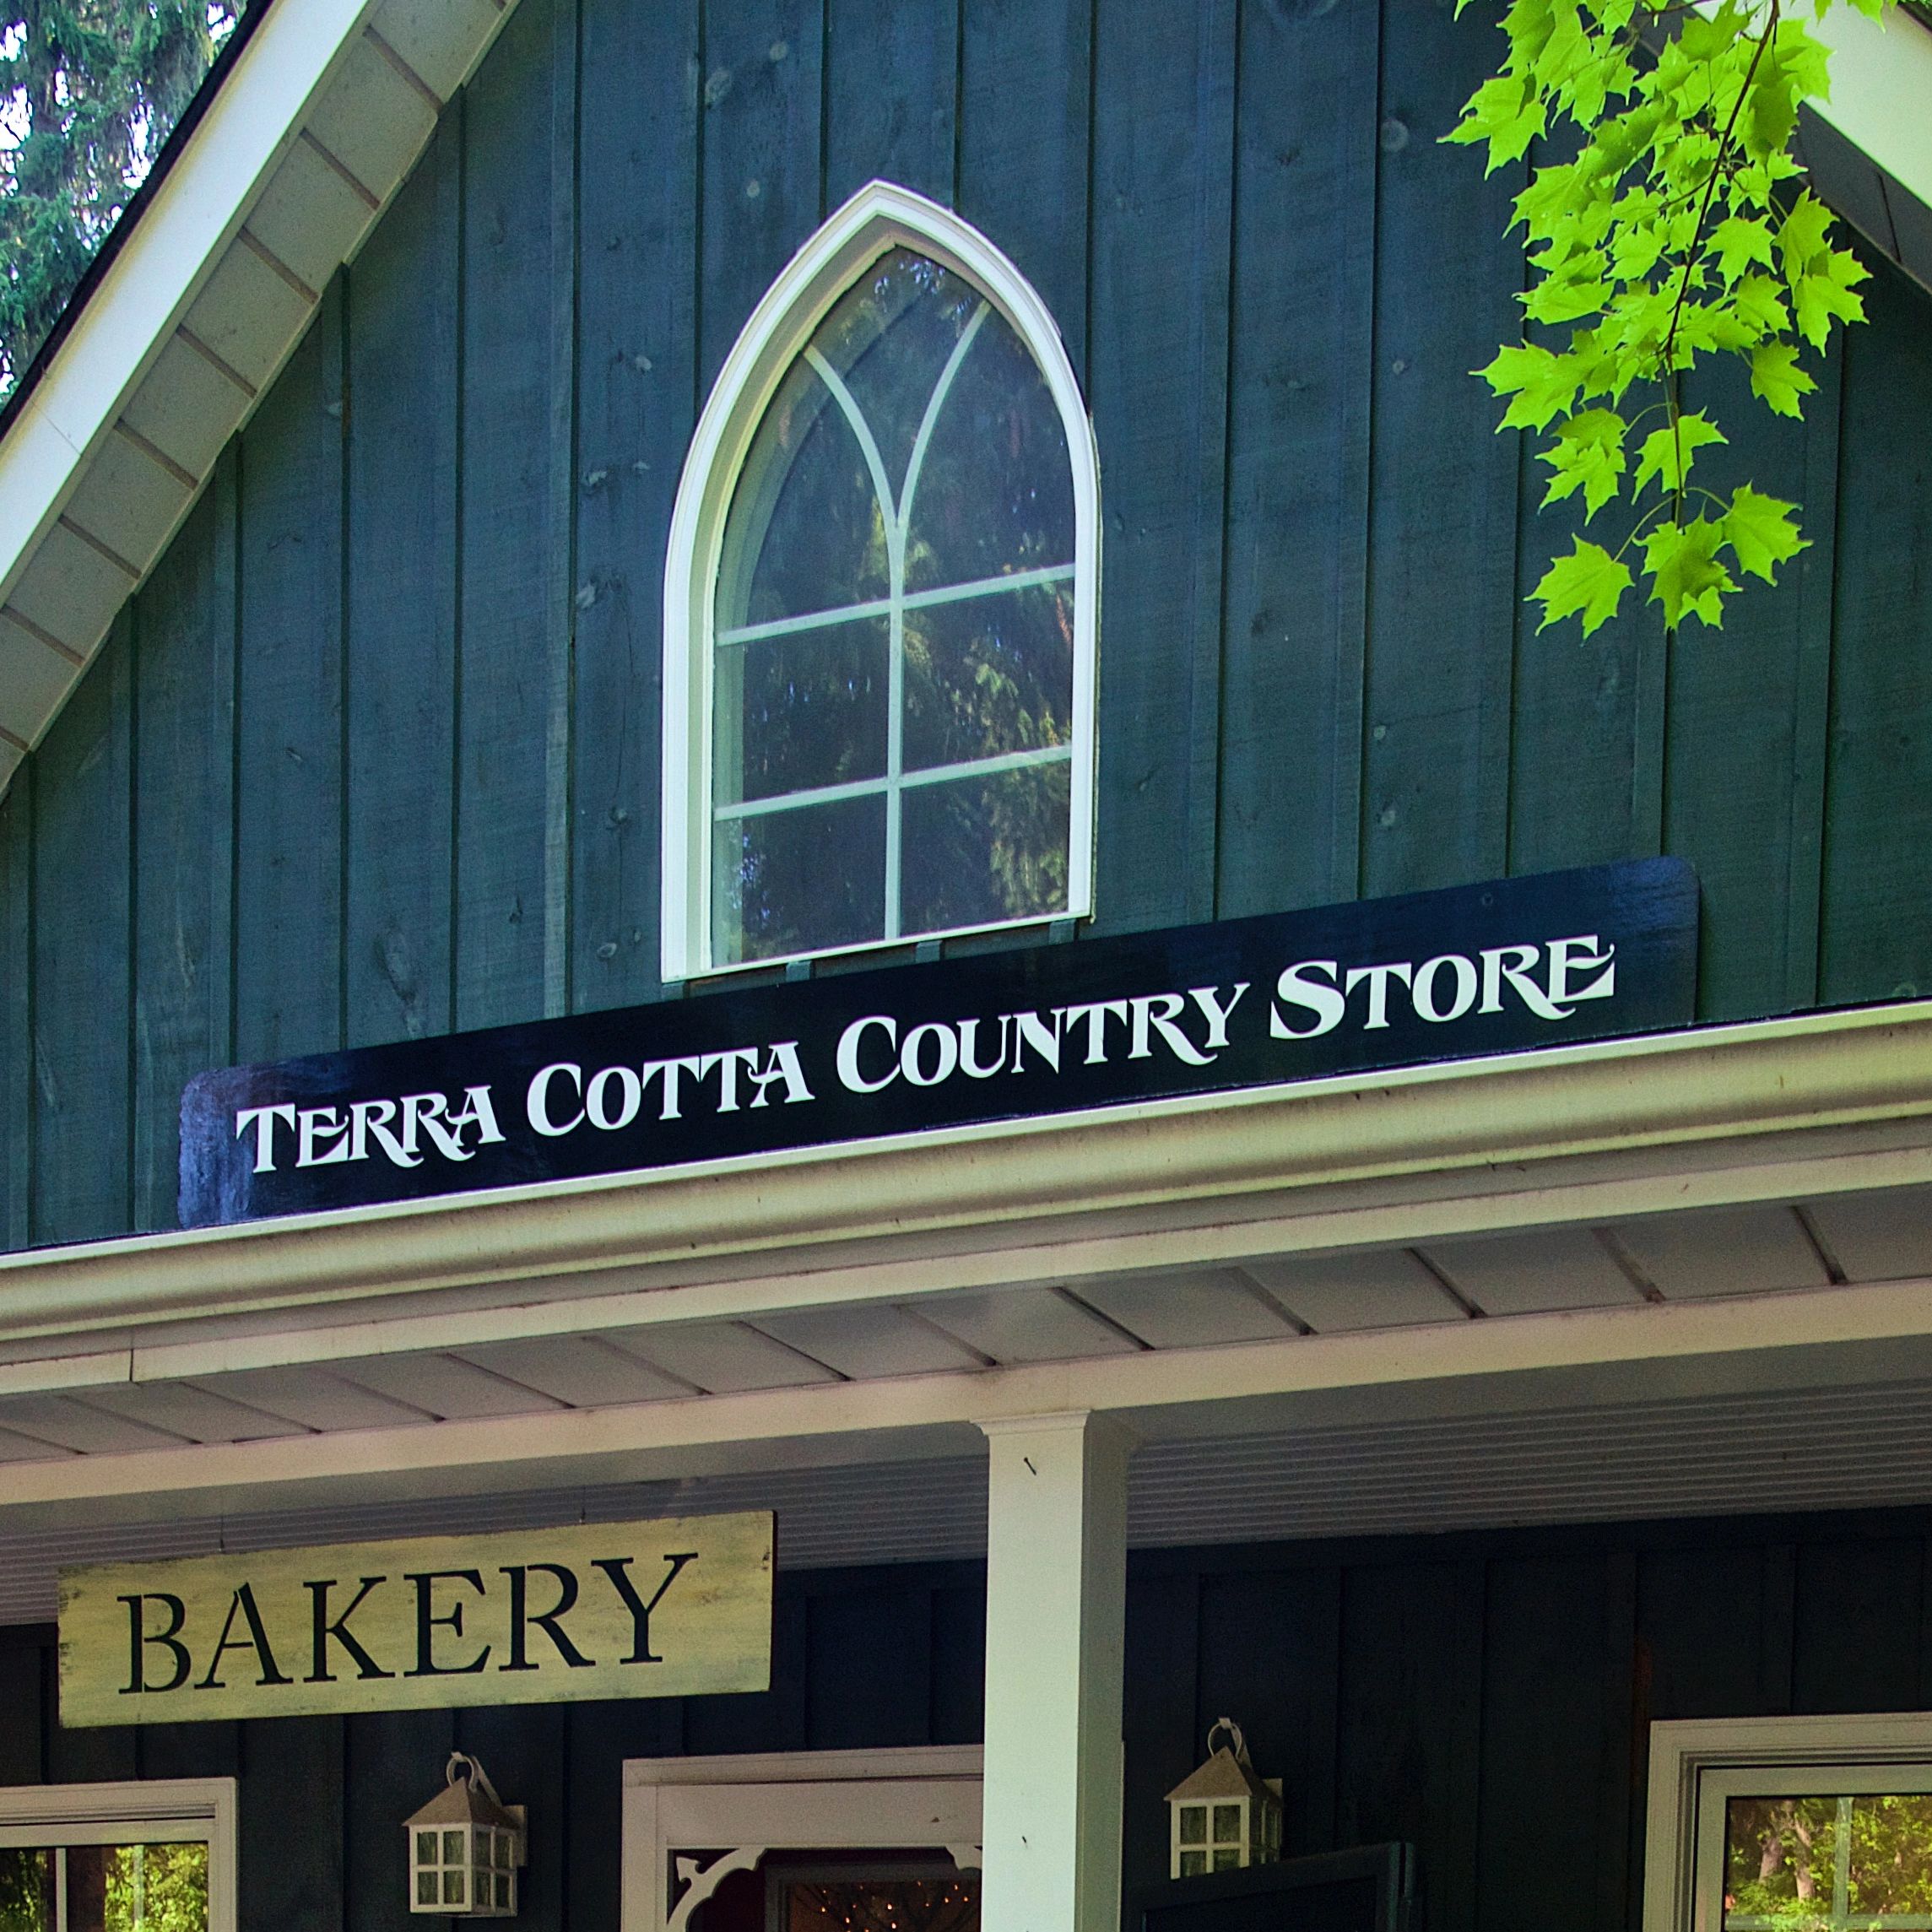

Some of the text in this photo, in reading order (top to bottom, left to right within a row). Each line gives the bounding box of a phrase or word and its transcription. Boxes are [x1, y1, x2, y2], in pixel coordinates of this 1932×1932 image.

[235, 934, 1615, 1174] TERRA COTTA COUNTRY STORE
[116, 1551, 699, 1695] BAKERY
